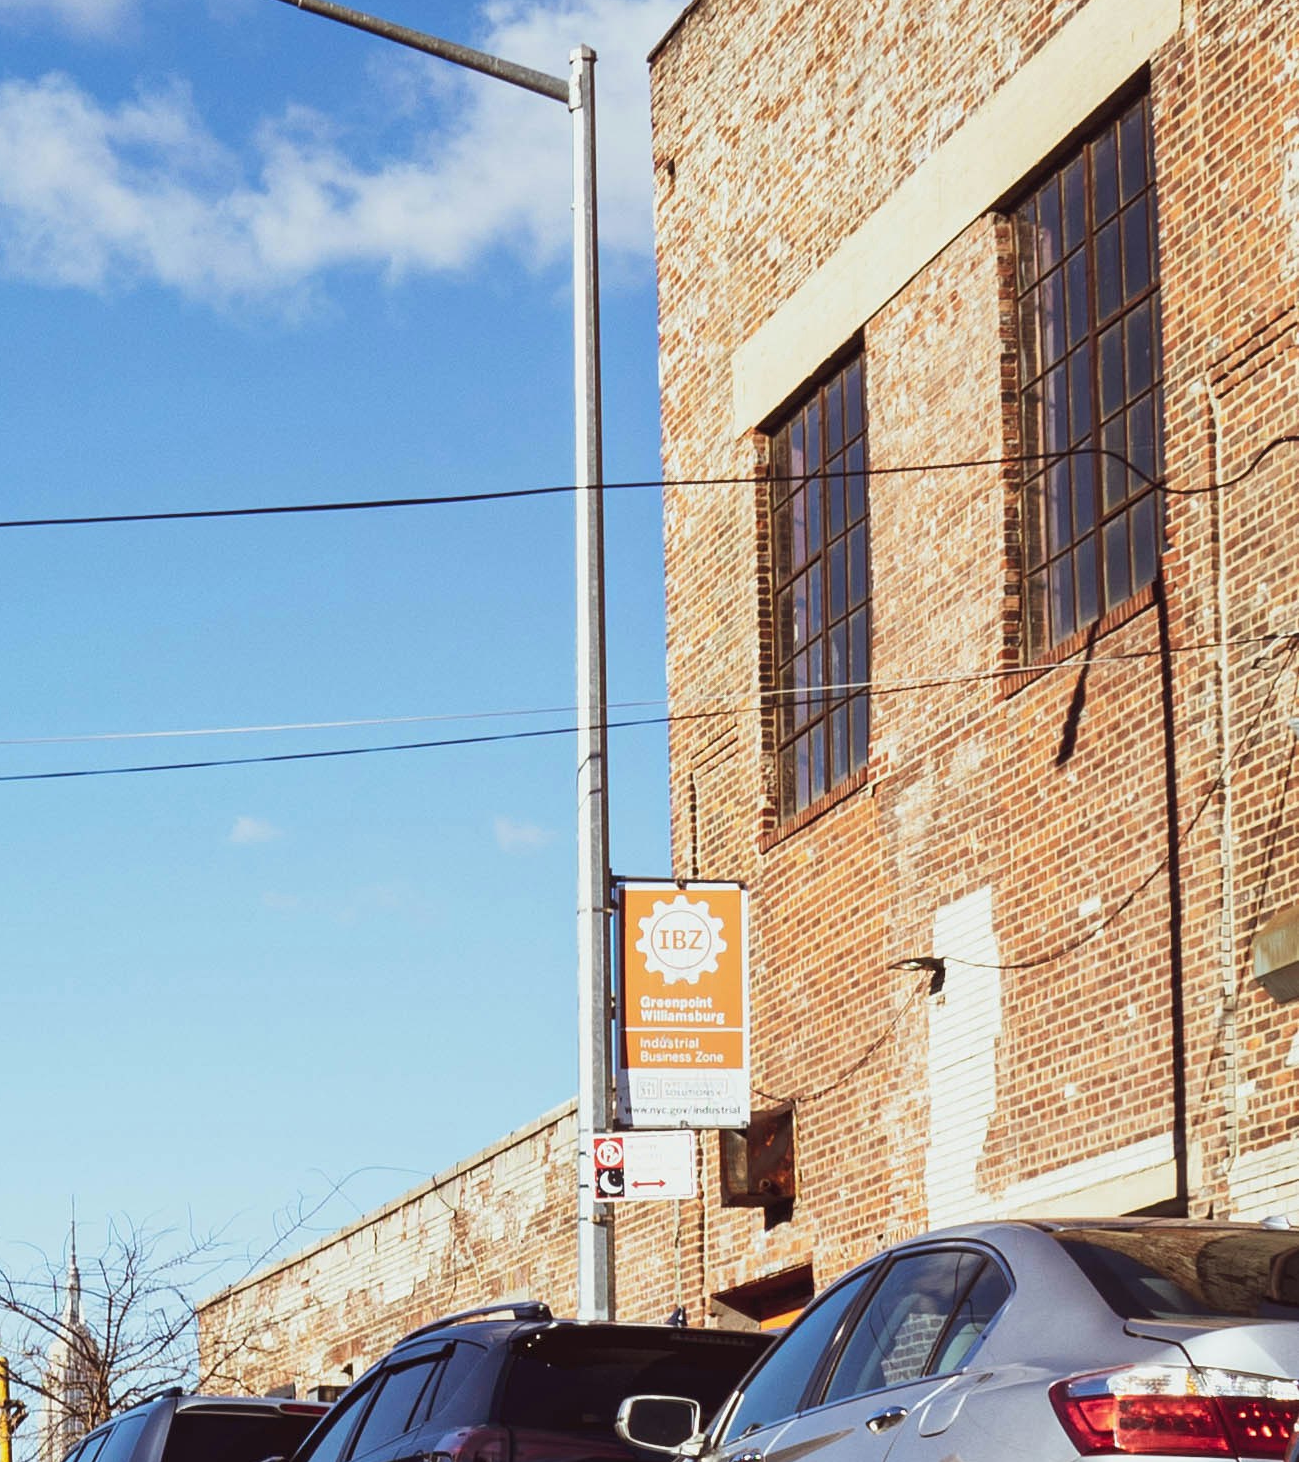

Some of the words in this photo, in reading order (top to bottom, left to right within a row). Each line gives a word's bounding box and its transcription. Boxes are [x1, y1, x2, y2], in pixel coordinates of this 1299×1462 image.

[659, 929, 703, 950] IBZ
[640, 996, 713, 1011] Greenpoint
[640, 1010, 725, 1025] Williamsburg
[640, 1037, 700, 1049] Industrial
[640, 1051, 692, 1063] Business
[695, 1051, 724, 1063] Zone
[624, 1105, 741, 1116] www.nyc.gov/industrial
